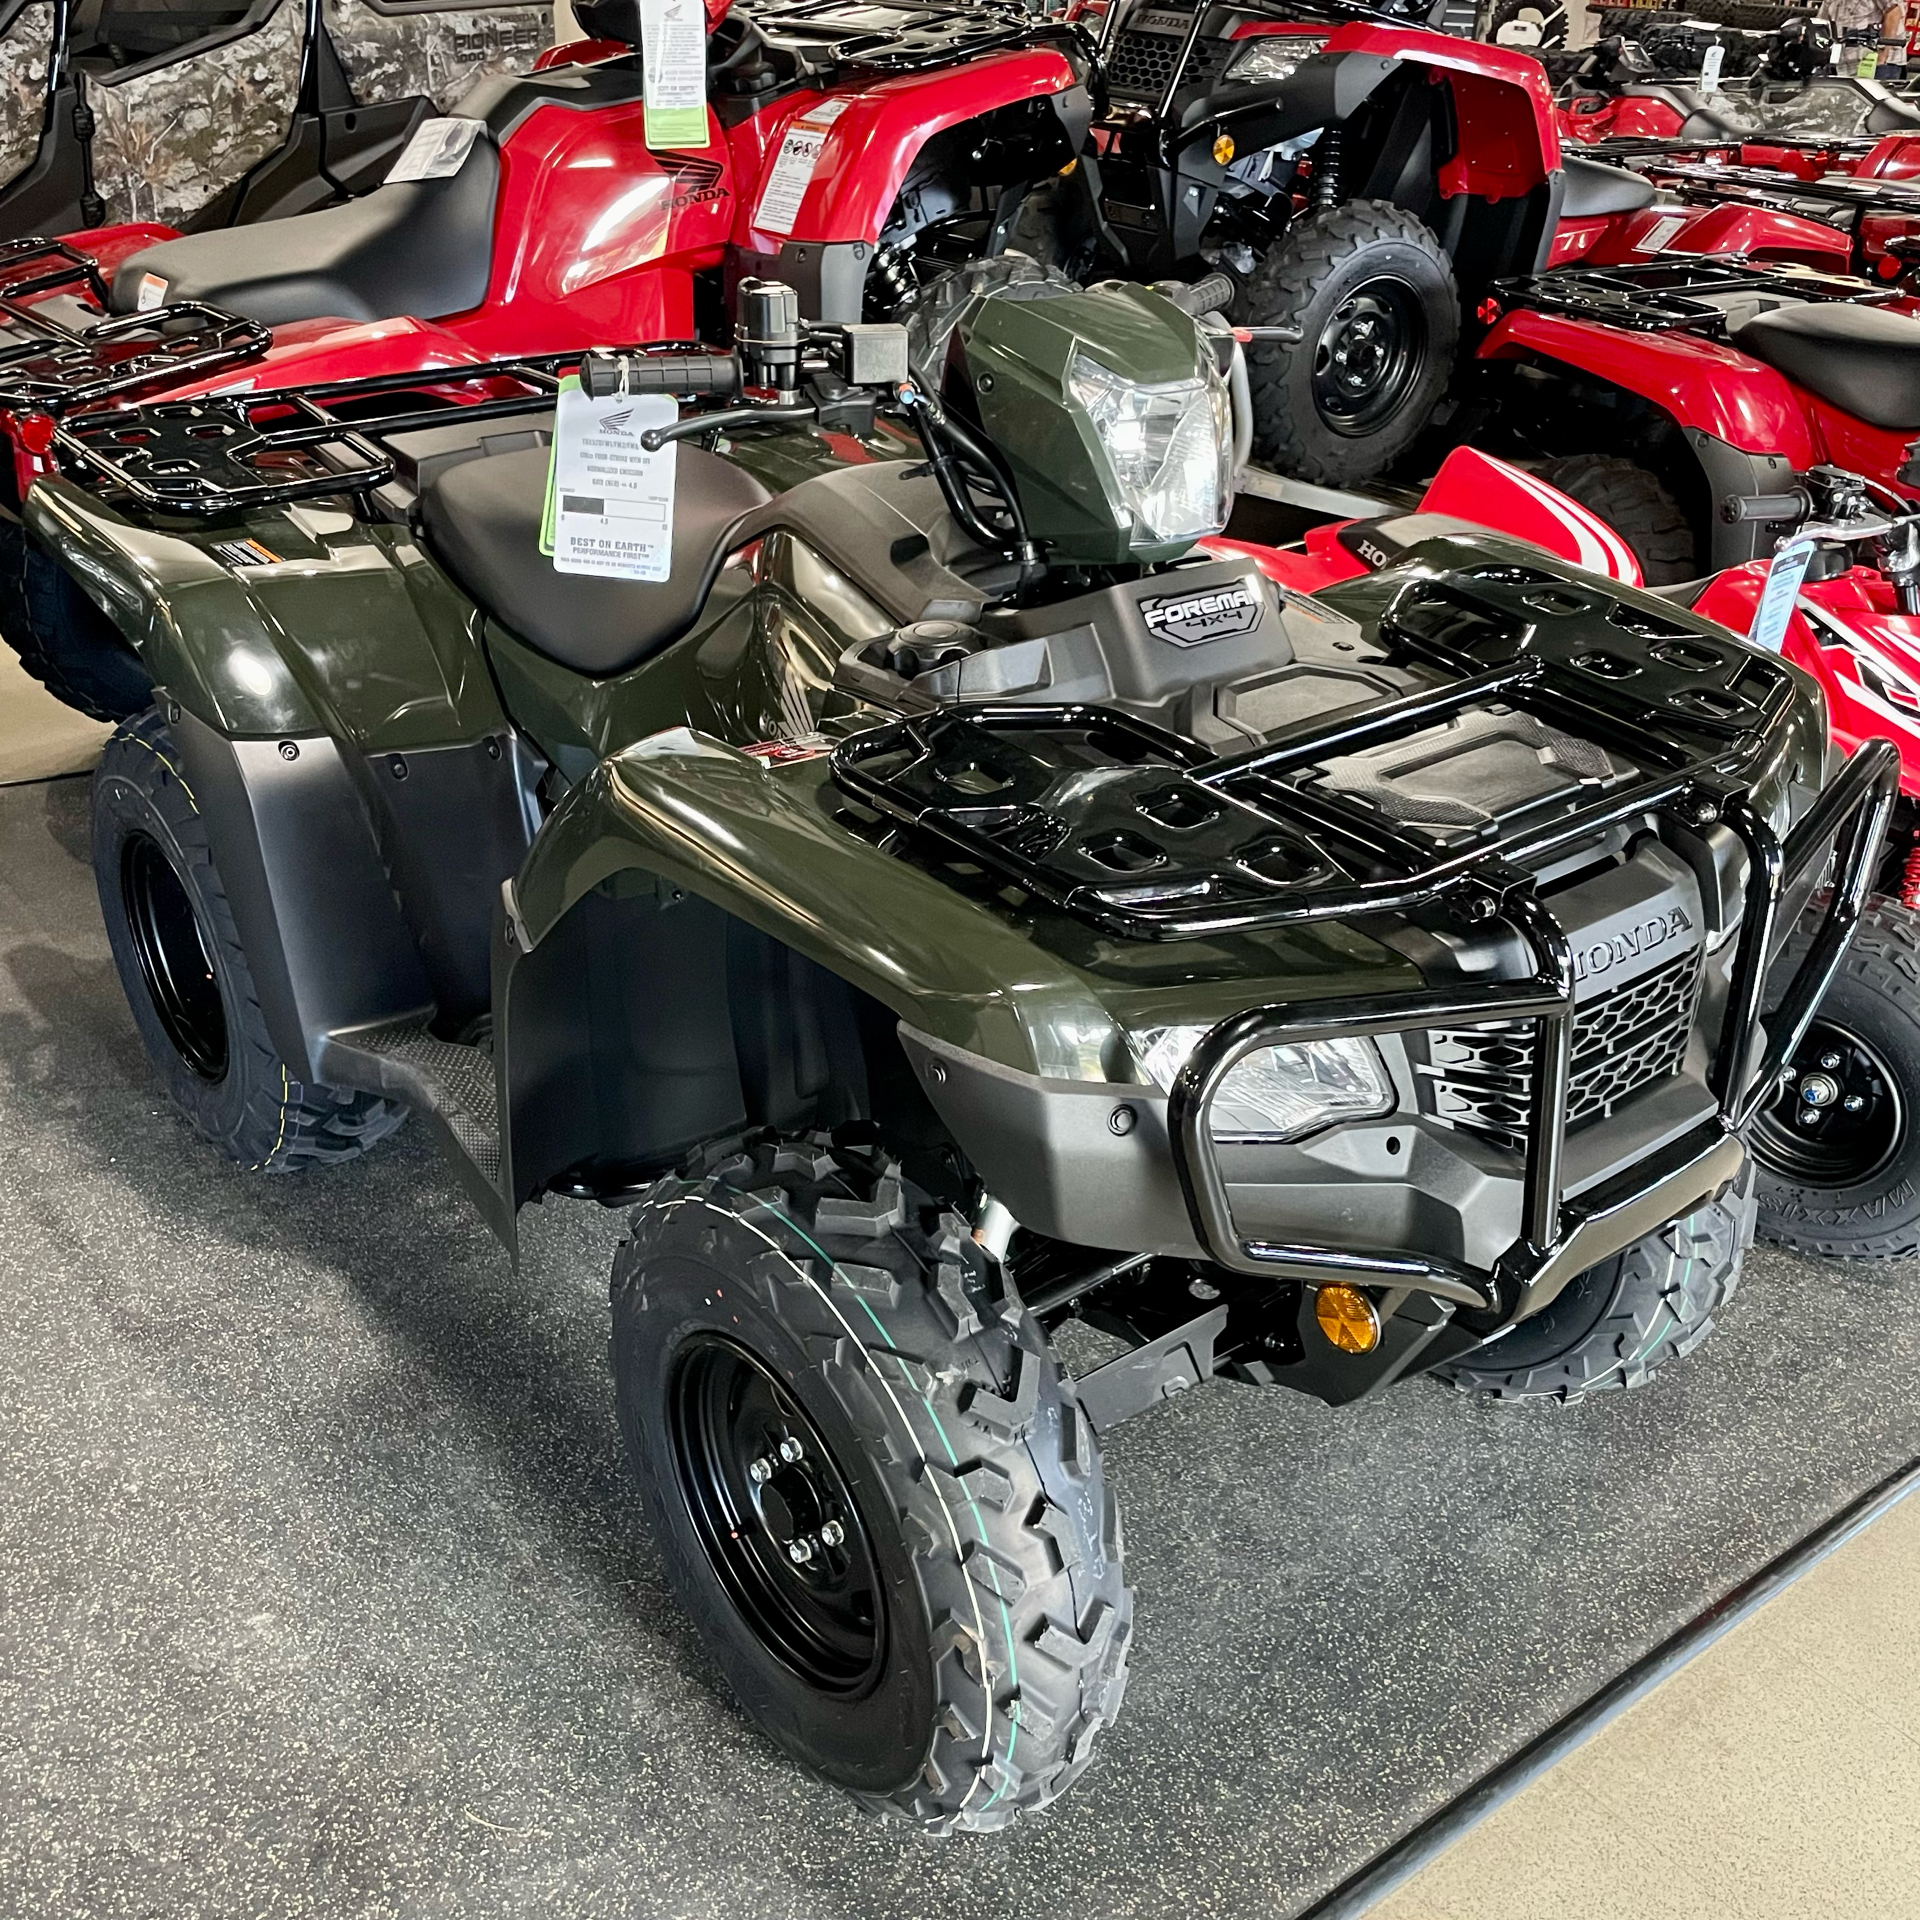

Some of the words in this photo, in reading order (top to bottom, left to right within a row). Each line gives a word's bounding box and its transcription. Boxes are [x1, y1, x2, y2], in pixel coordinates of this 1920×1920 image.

[1134, 14, 1190, 30] HONDA
[454, 27, 539, 50] PIONEER
[660, 186, 731, 211] HONDA
[598, 428, 635, 437] HONDA
[628, 482, 638, 490] 4.0
[600, 518, 609, 526] 4.0
[570, 536, 596, 547] BEST
[598, 539, 612, 549] ON
[572, 546, 622, 558] PERFORMANCE
[1757, 1178, 1917, 1226] MAXXIS
